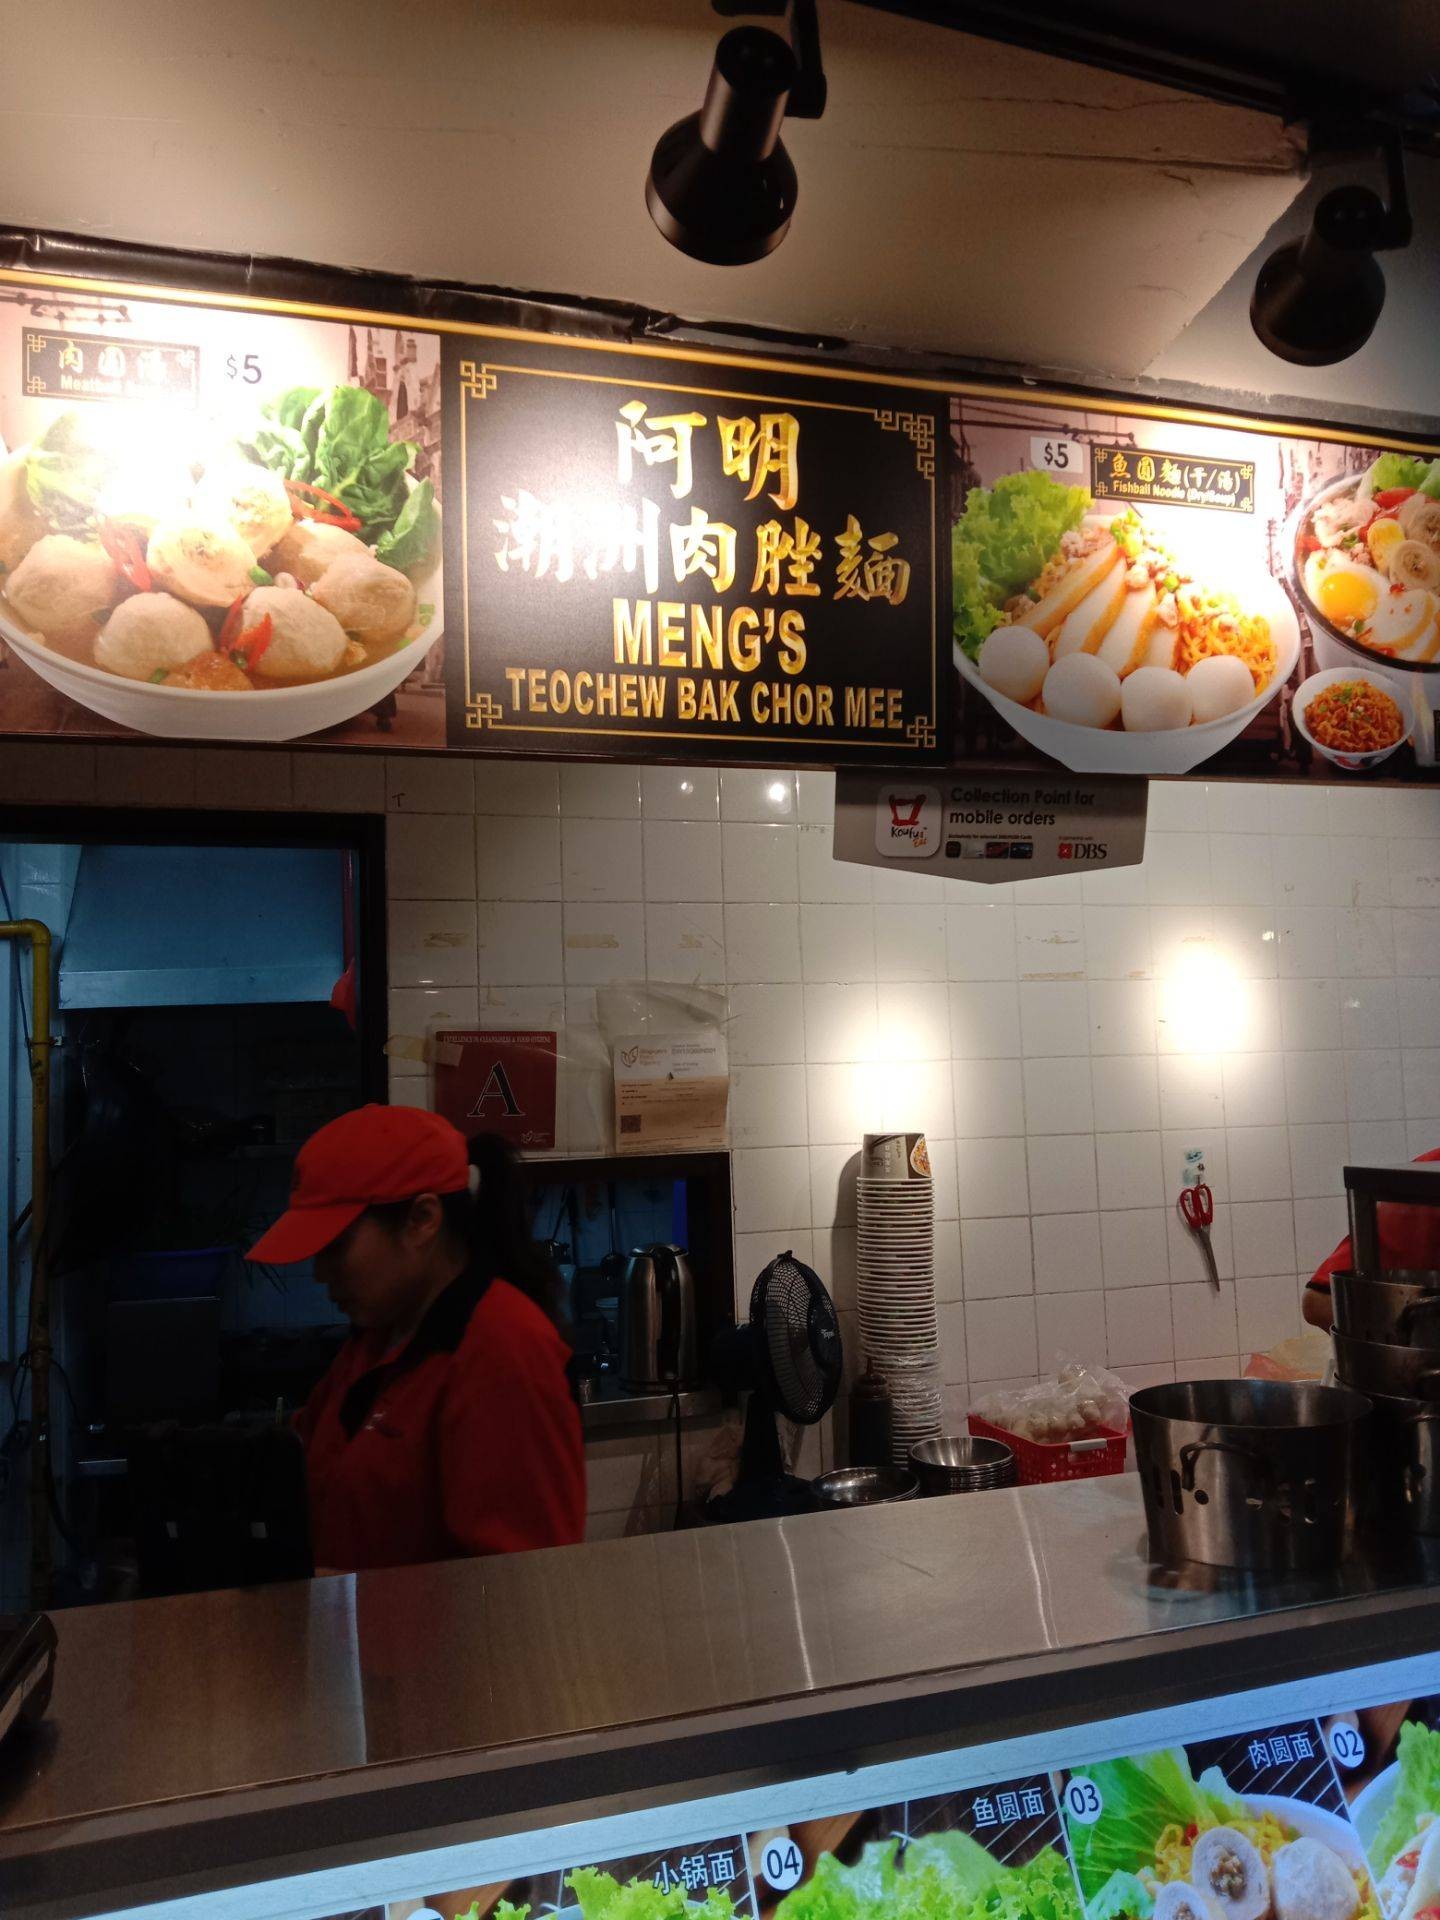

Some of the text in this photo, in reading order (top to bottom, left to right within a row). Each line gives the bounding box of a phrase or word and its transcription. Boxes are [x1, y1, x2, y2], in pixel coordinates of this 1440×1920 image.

[225, 353, 263, 385] $5
[615, 400, 801, 511] 阿明
[1044, 442, 1069, 469] $5
[613, 598, 807, 675] MENG'S
[505, 667, 904, 729] TEOCHEW BAK CHOR MEE
[950, 787, 1095, 805] Collection Point for
[949, 809, 1055, 825] mobile orders
[1074, 843, 1108, 860] DBS
[466, 1060, 527, 1117] A
[1248, 1731, 1314, 1770] 肉圆面
[1333, 1729, 1364, 1758] 02
[971, 1786, 1046, 1829] 鱼圆面
[1069, 1783, 1100, 1815] 03
[652, 1848, 737, 1896] 小锅面
[766, 1844, 800, 1879] 04
